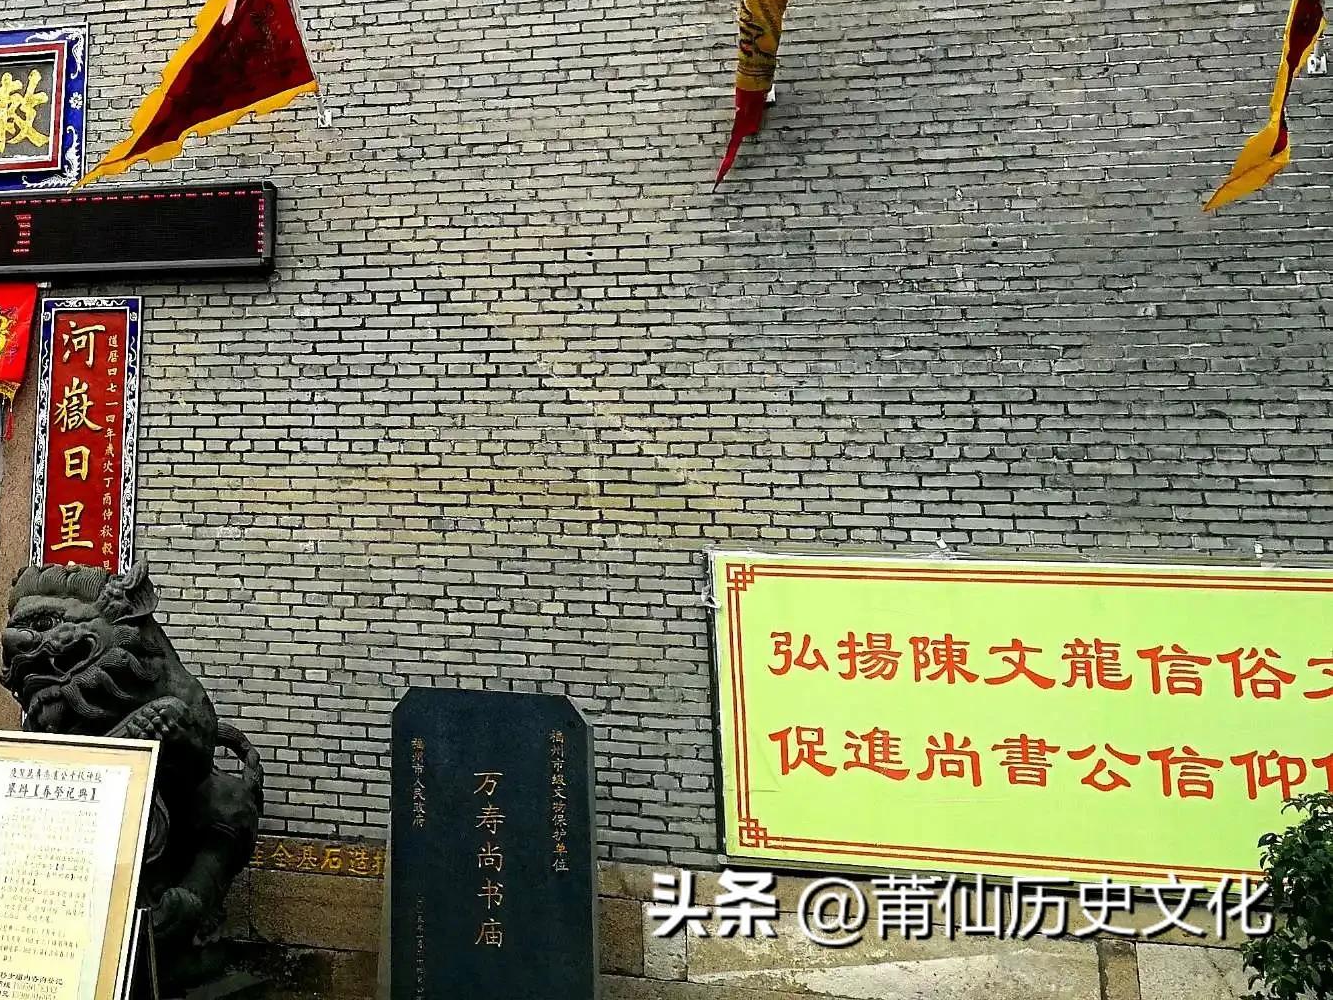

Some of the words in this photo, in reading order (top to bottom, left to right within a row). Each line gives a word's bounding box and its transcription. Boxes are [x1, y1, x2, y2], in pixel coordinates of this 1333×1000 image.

[51, 320, 106, 567] 河嶽日星
[768, 725, 1333, 803] 促進尚書公信仰
[473, 771, 506, 948] 万寿尚书庙
